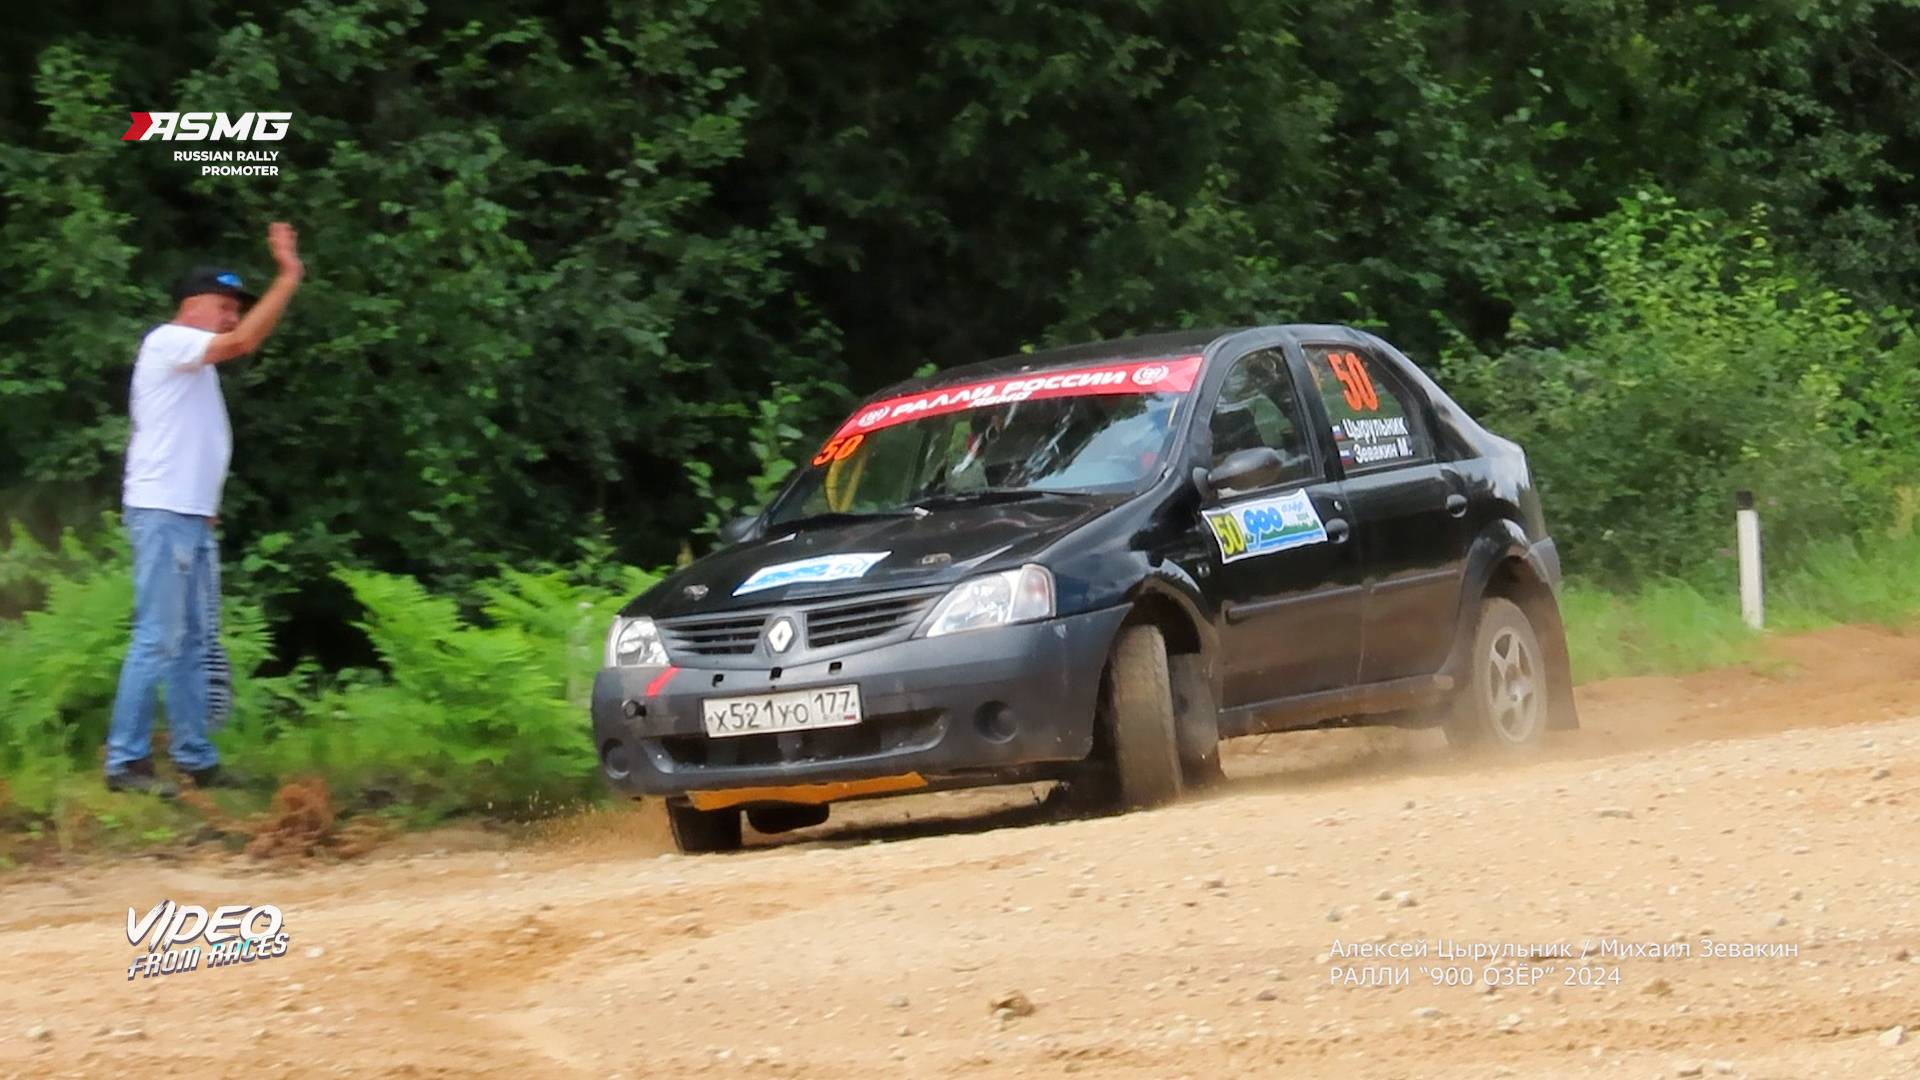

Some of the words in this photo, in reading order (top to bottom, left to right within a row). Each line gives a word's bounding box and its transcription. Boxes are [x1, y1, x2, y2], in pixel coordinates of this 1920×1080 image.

[890, 384, 996, 418] РАЛЛИ
[1001, 371, 1127, 396] РОССИИ
[1327, 352, 1379, 412] 50
[812, 434, 865, 466] 50
[1341, 417, 1409, 445] Цырульник
[1211, 514, 1245, 556] 50
[1243, 506, 1284, 548] 900
[813, 691, 850, 714] 177
